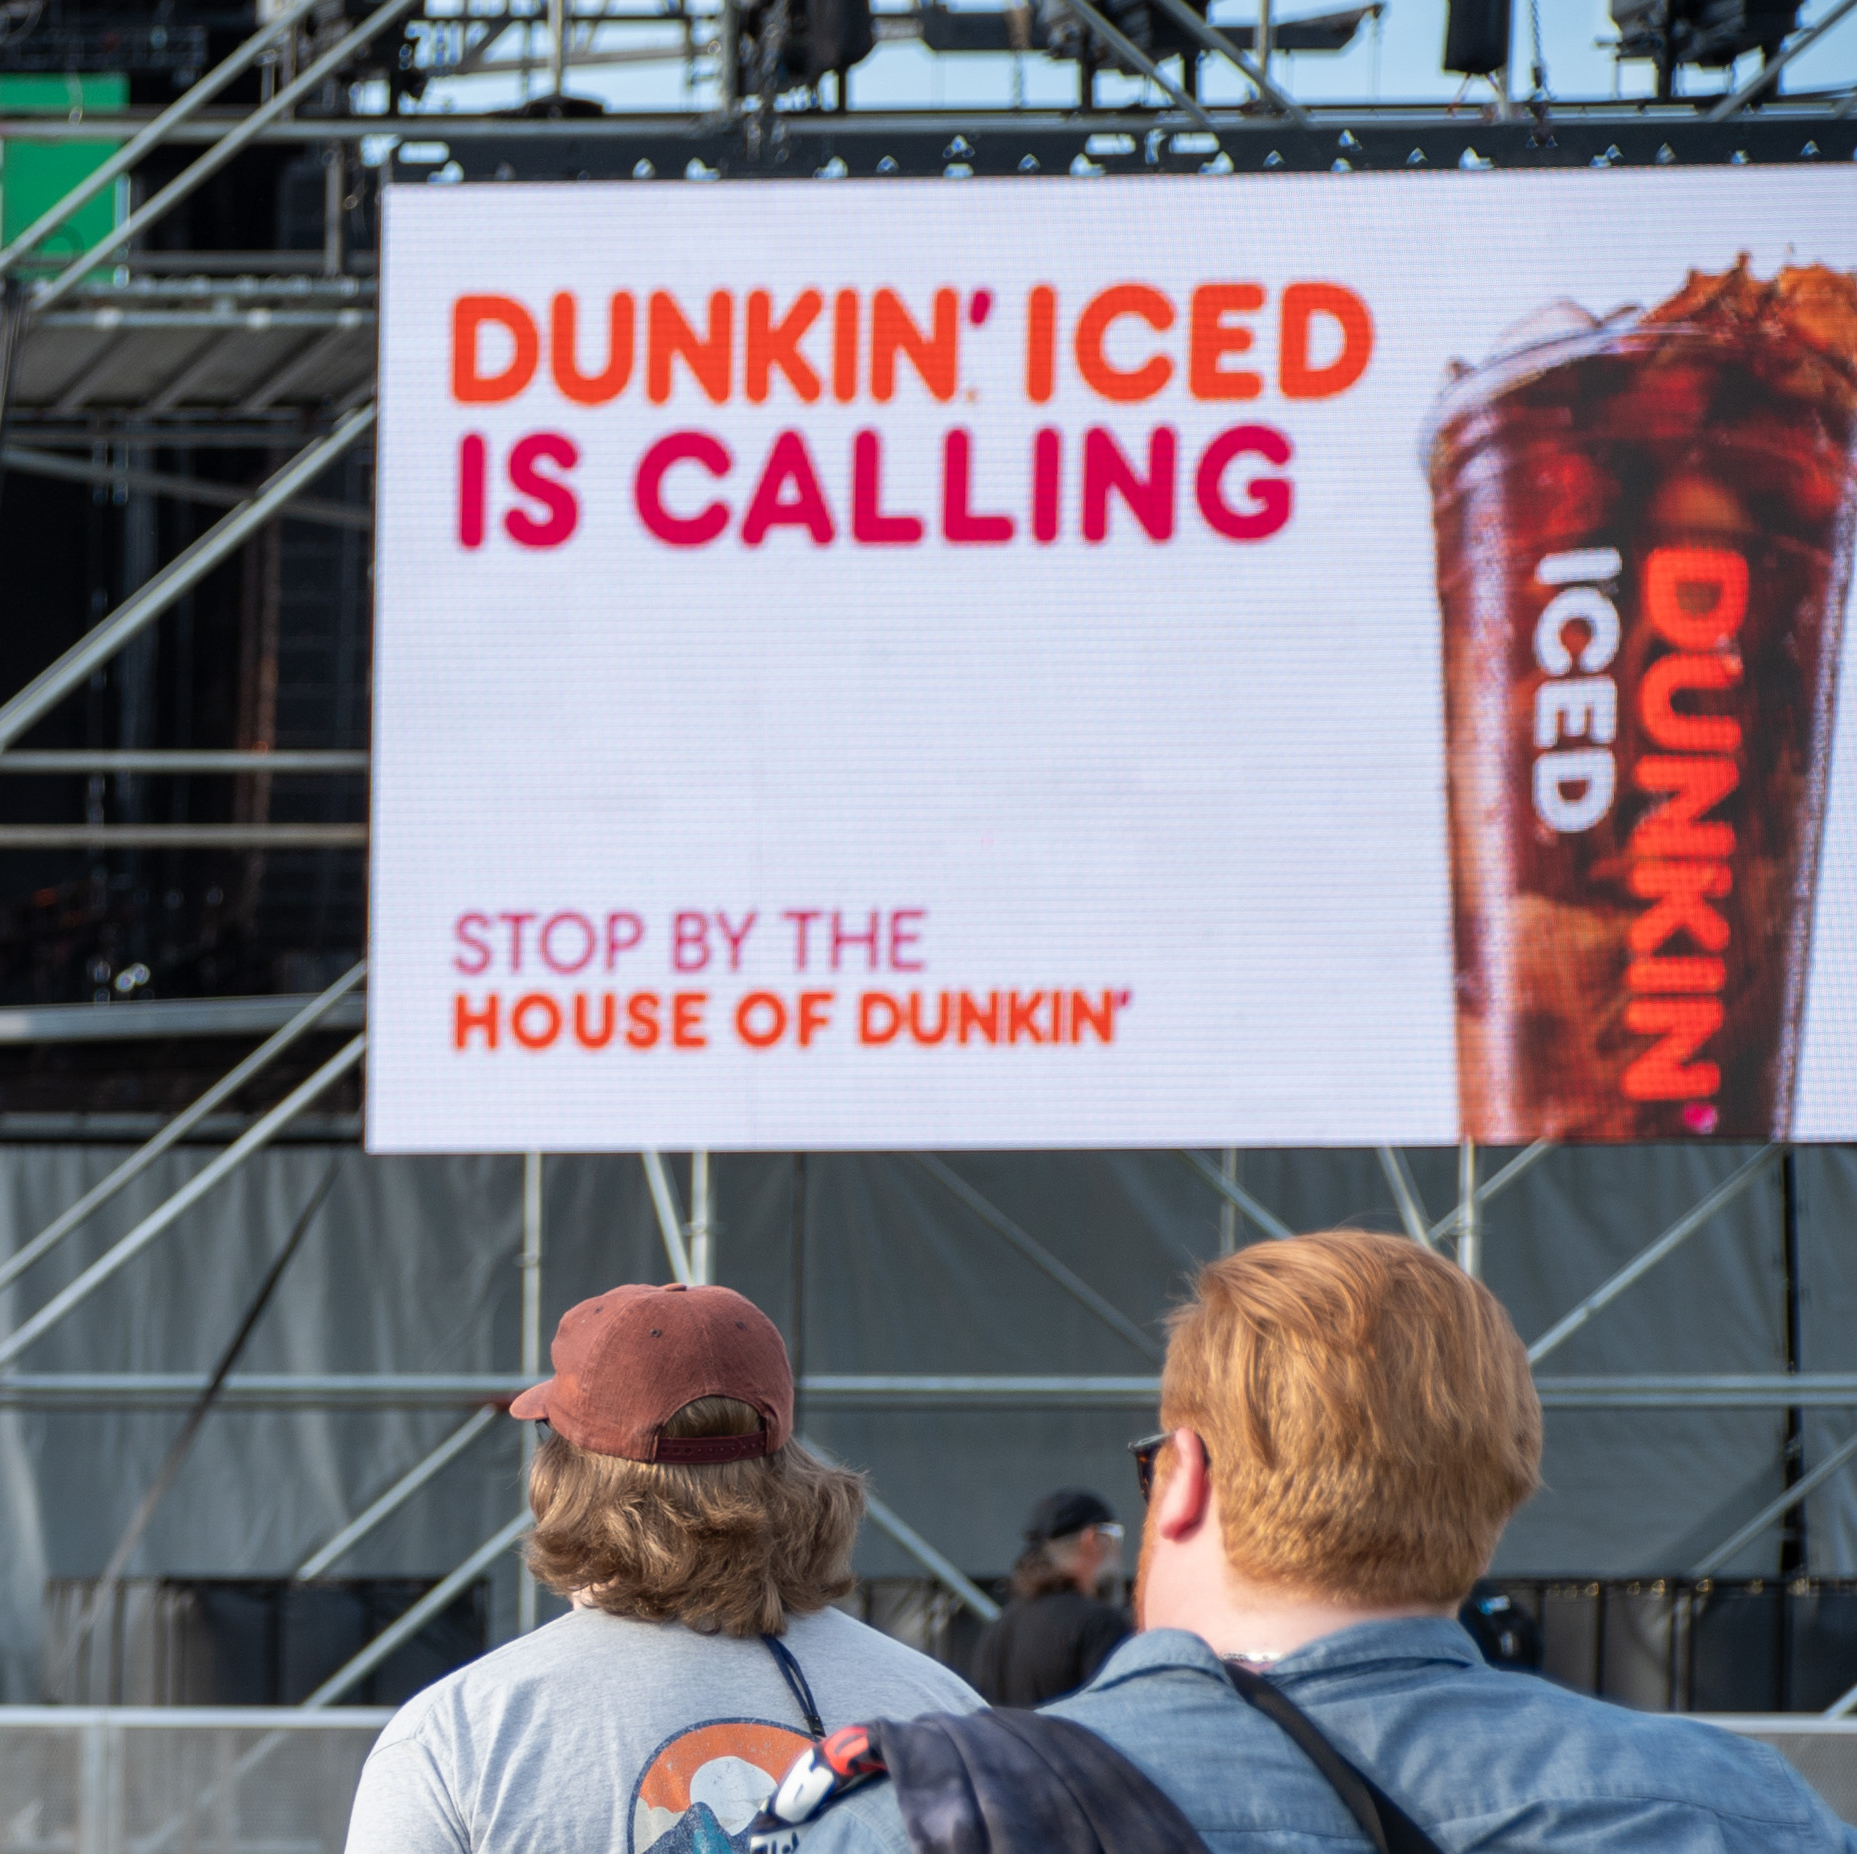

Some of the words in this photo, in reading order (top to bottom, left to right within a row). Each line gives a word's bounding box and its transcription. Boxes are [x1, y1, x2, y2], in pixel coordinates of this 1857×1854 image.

[450, 284, 994, 406] DUNKIN'
[1025, 281, 1376, 405] ICED
[457, 430, 580, 551] IS
[632, 422, 1295, 549] CALLING
[1532, 546, 1623, 834] ICED
[1621, 545, 1750, 1134] DUNKIN'
[456, 911, 645, 975] STOP
[672, 910, 758, 973] BY
[783, 909, 927, 972] THE
[453, 990, 709, 1051] HOUSE
[732, 989, 836, 1050] OF
[857, 988, 1133, 1049] DUNKIN'
